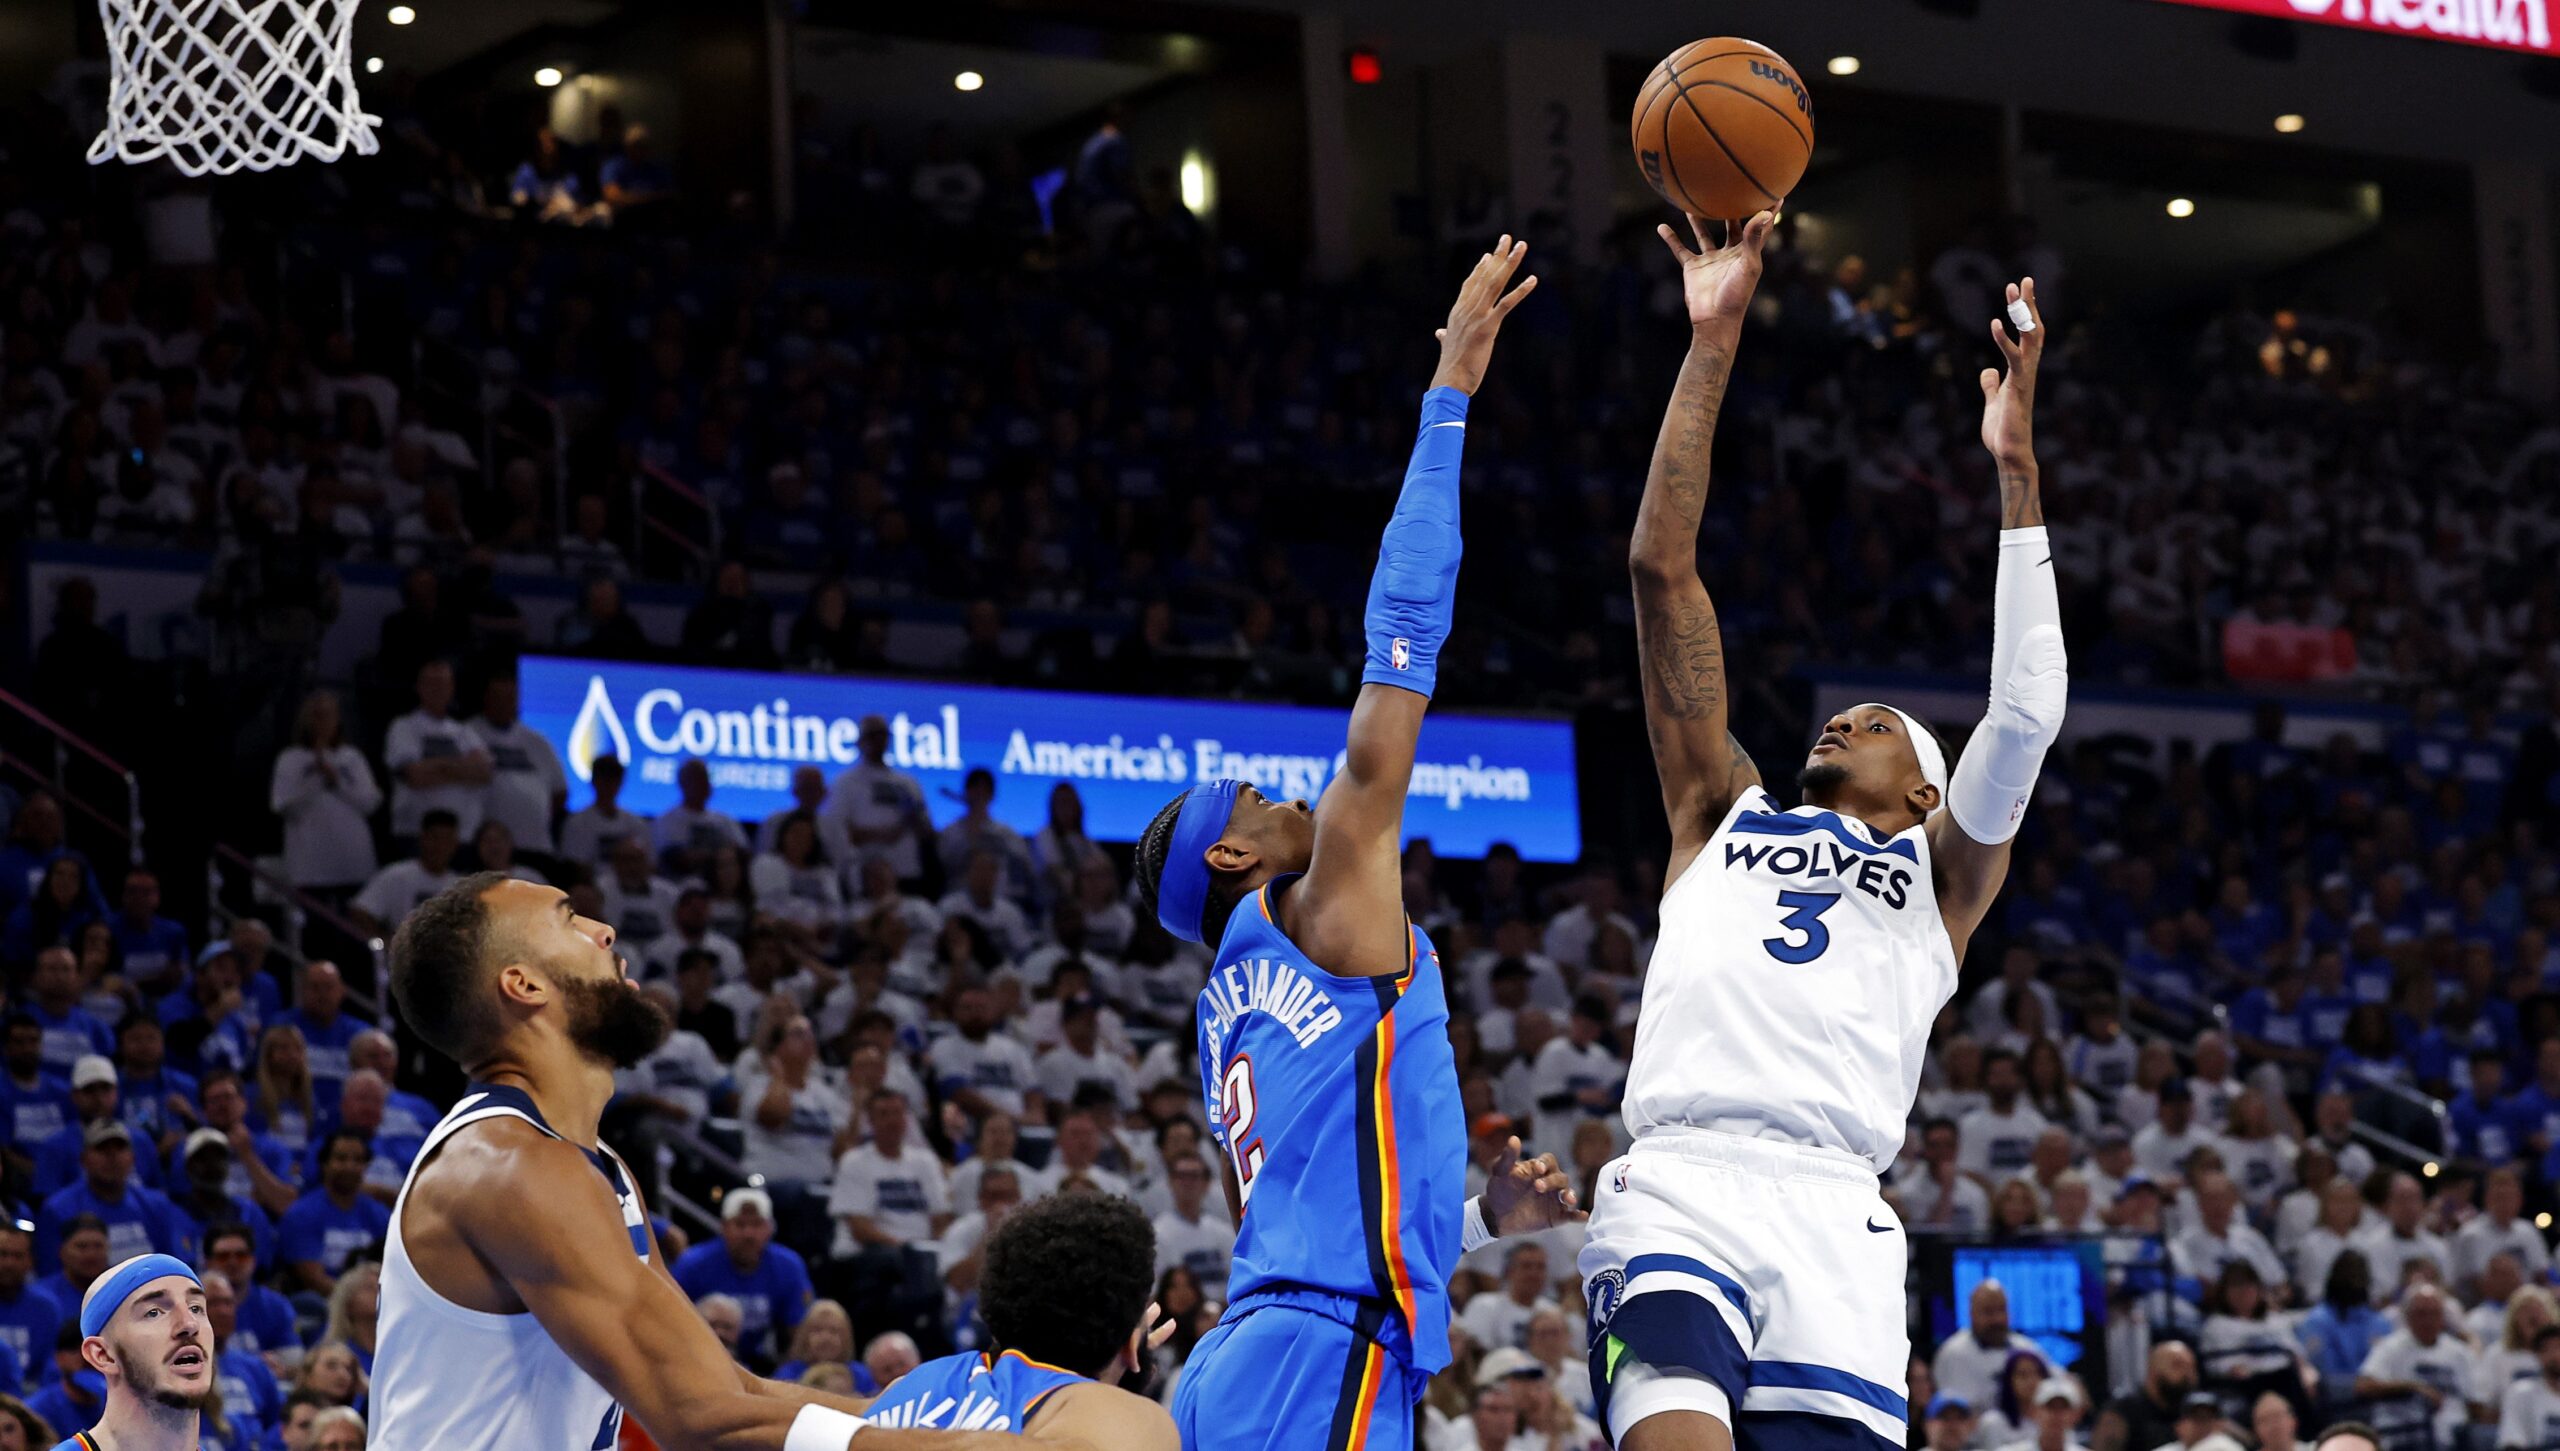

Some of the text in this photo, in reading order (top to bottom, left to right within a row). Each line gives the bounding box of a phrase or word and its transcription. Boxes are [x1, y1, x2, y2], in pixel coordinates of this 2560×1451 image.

[634, 688, 963, 770] Continetal
[1001, 728, 1531, 811] America's Energy mpion
[1725, 842, 1913, 910] WOLVES
[1762, 889, 1842, 965] 3
[1221, 1052, 1266, 1219] 2
